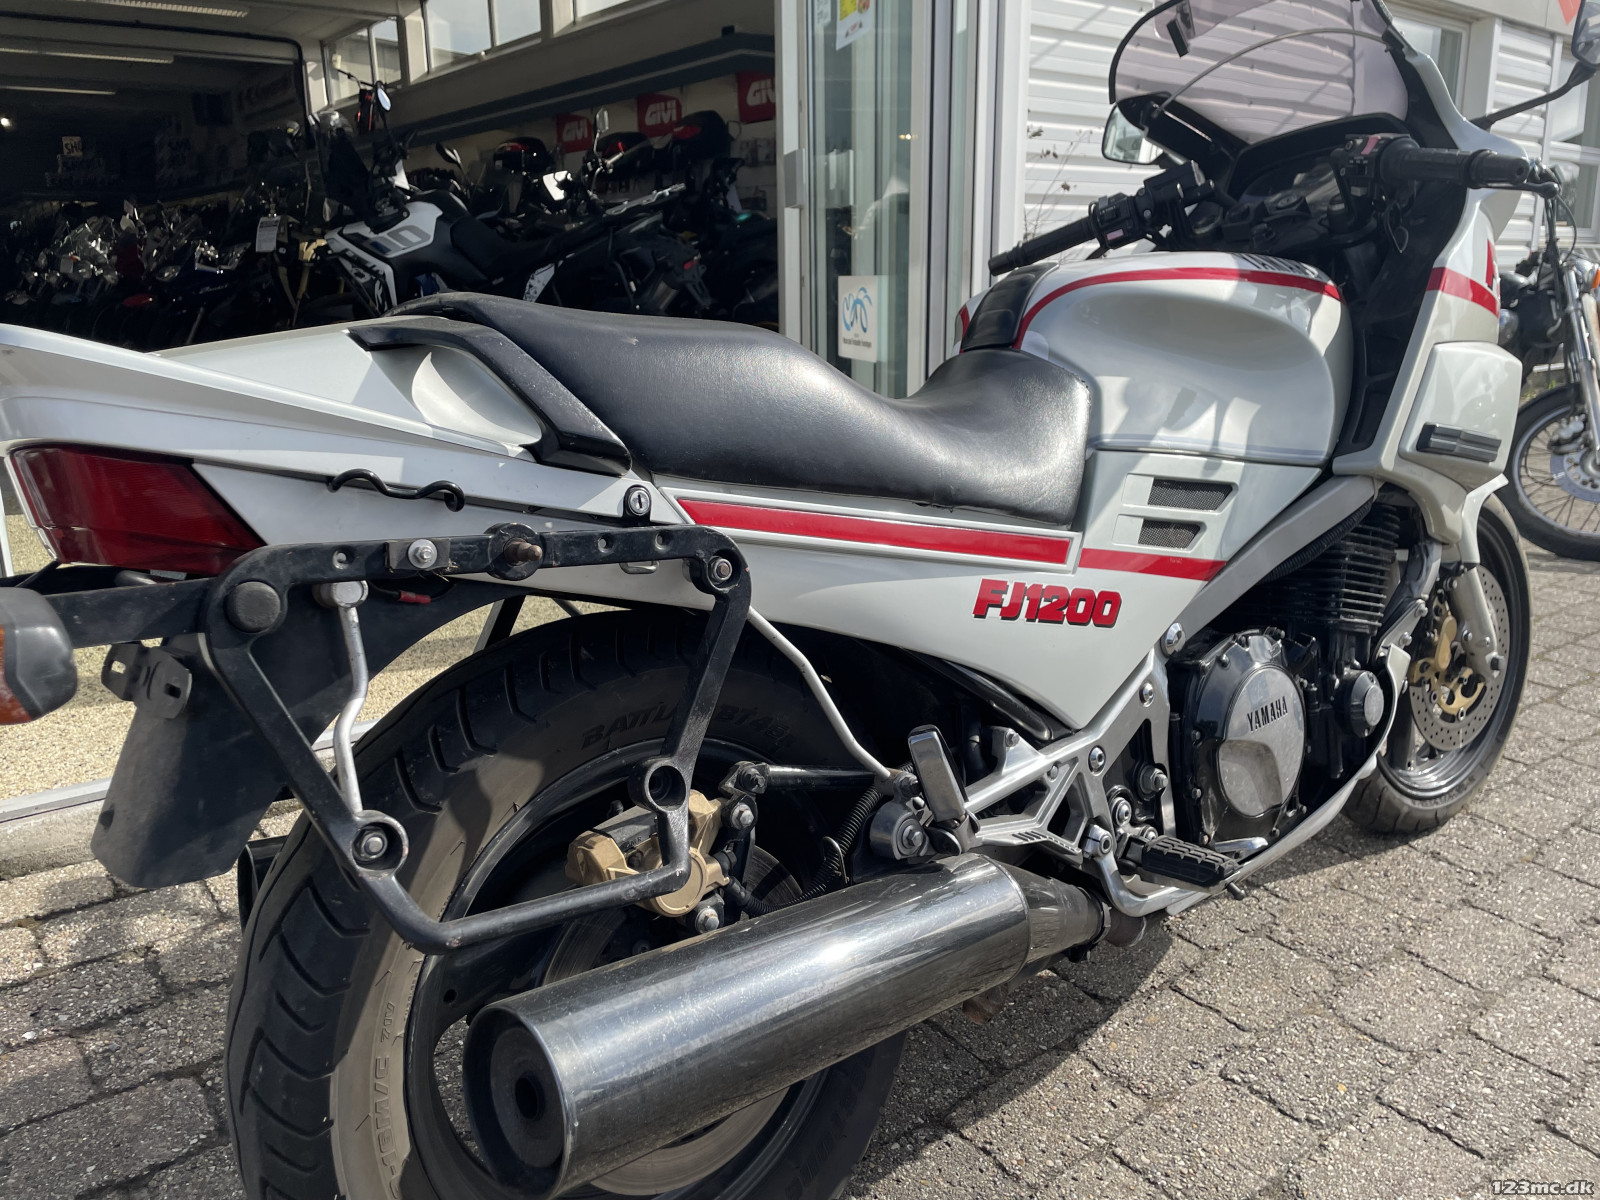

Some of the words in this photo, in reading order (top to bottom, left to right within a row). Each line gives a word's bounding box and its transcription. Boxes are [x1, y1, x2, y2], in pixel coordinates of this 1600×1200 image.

[644, 100, 677, 126] GIVI
[562, 119, 588, 143] GIVI
[973, 578, 1121, 628] FJ1200
[1247, 696, 1288, 732] YAMAHA
